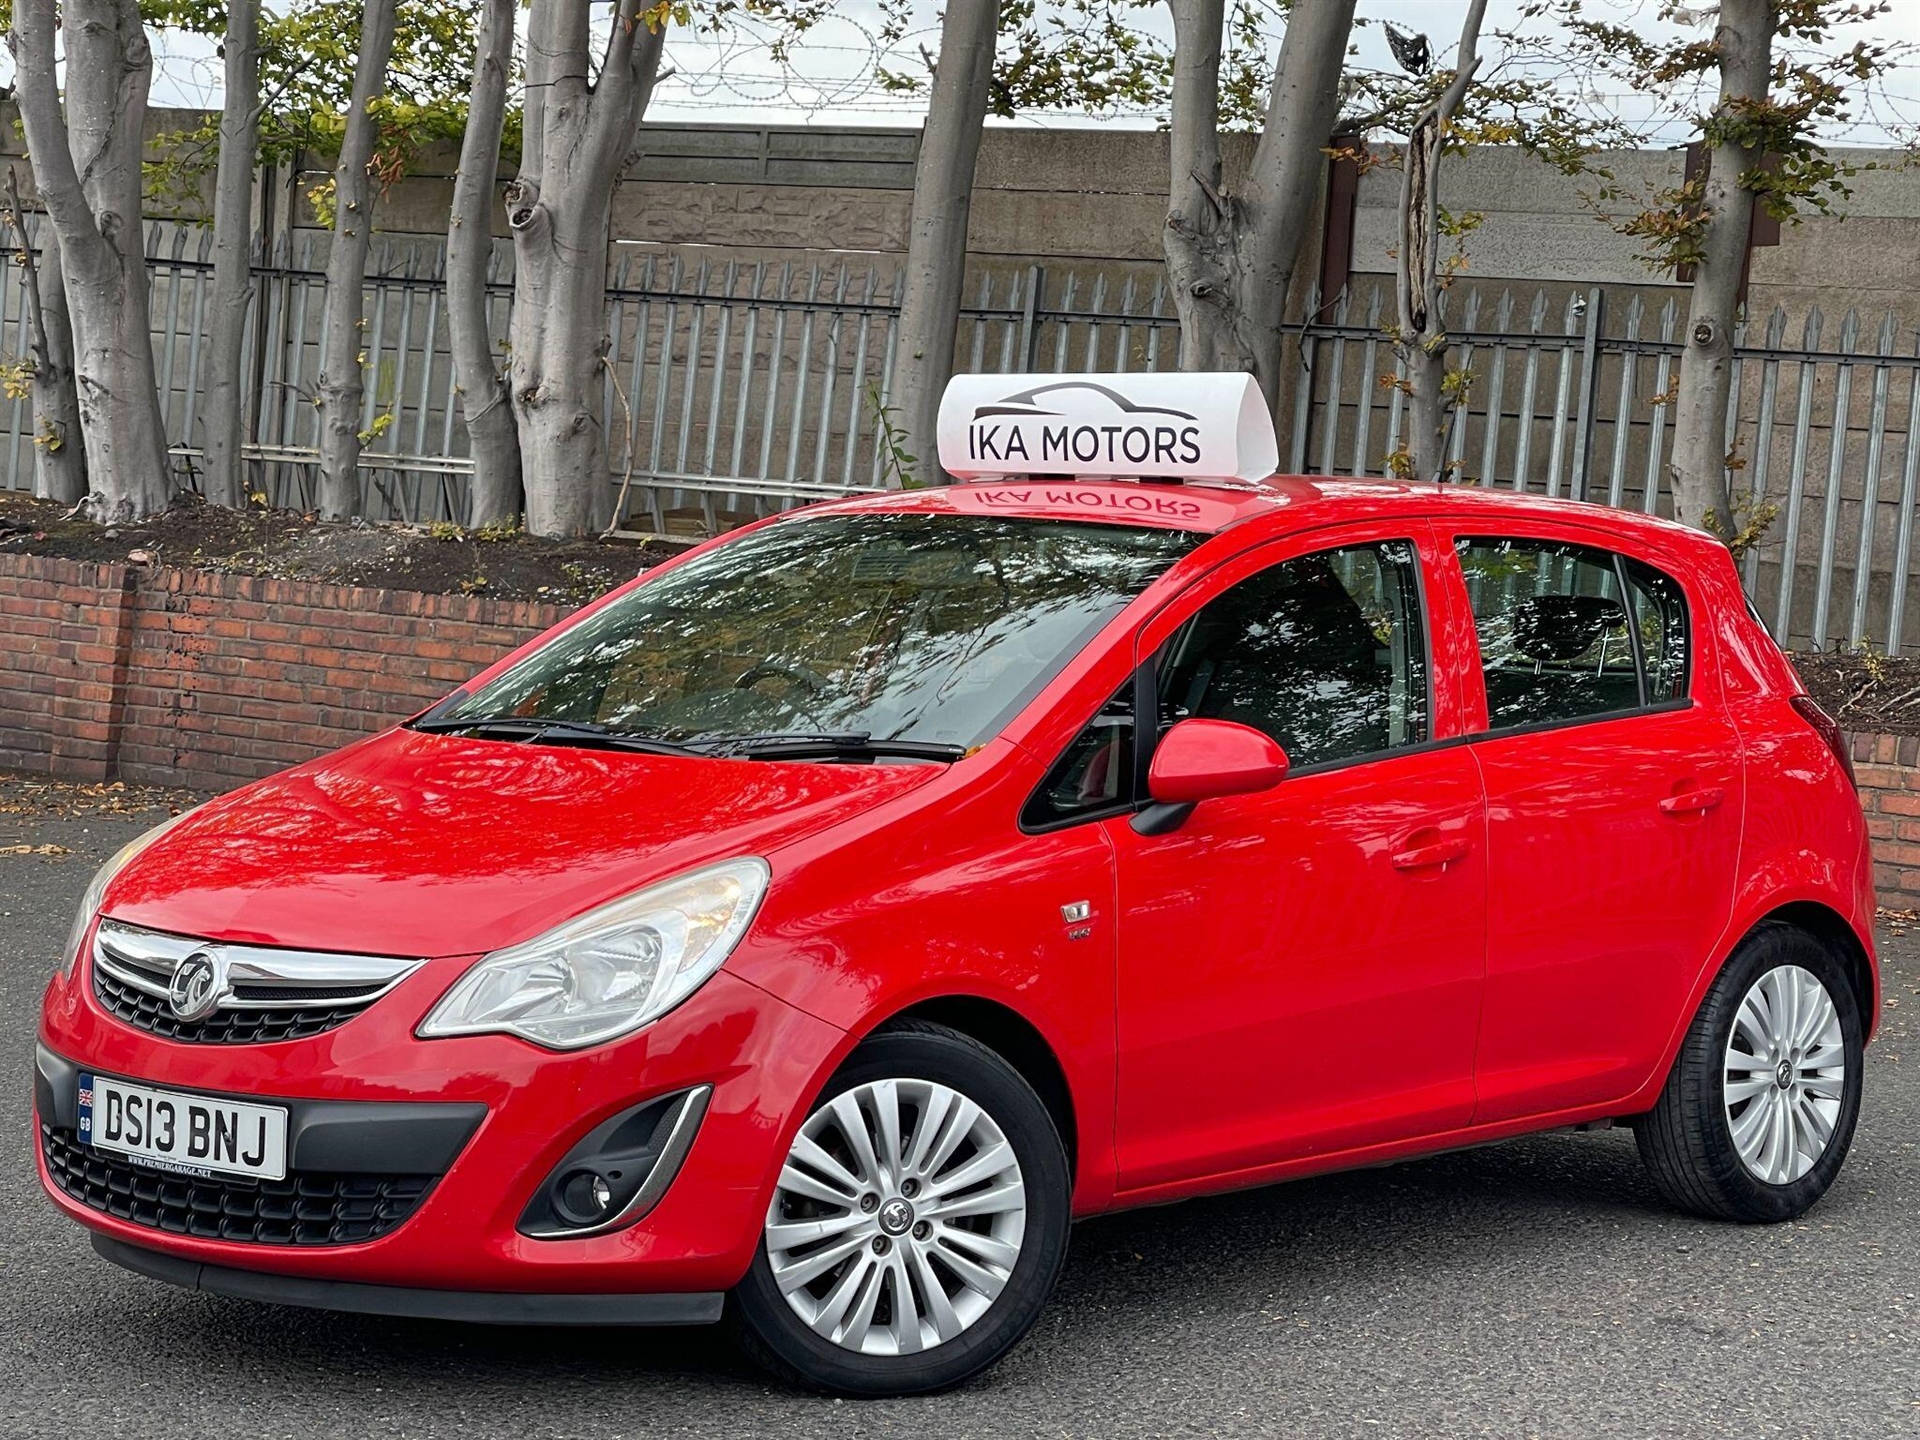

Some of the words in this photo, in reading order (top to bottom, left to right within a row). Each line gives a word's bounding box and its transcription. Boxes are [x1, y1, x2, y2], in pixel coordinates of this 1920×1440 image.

[969, 425, 1030, 461] IKA
[1043, 425, 1201, 464] MOTORS
[80, 1116, 91, 1131] GB
[105, 1089, 175, 1152] DS13
[187, 1105, 266, 1167] BNJ
